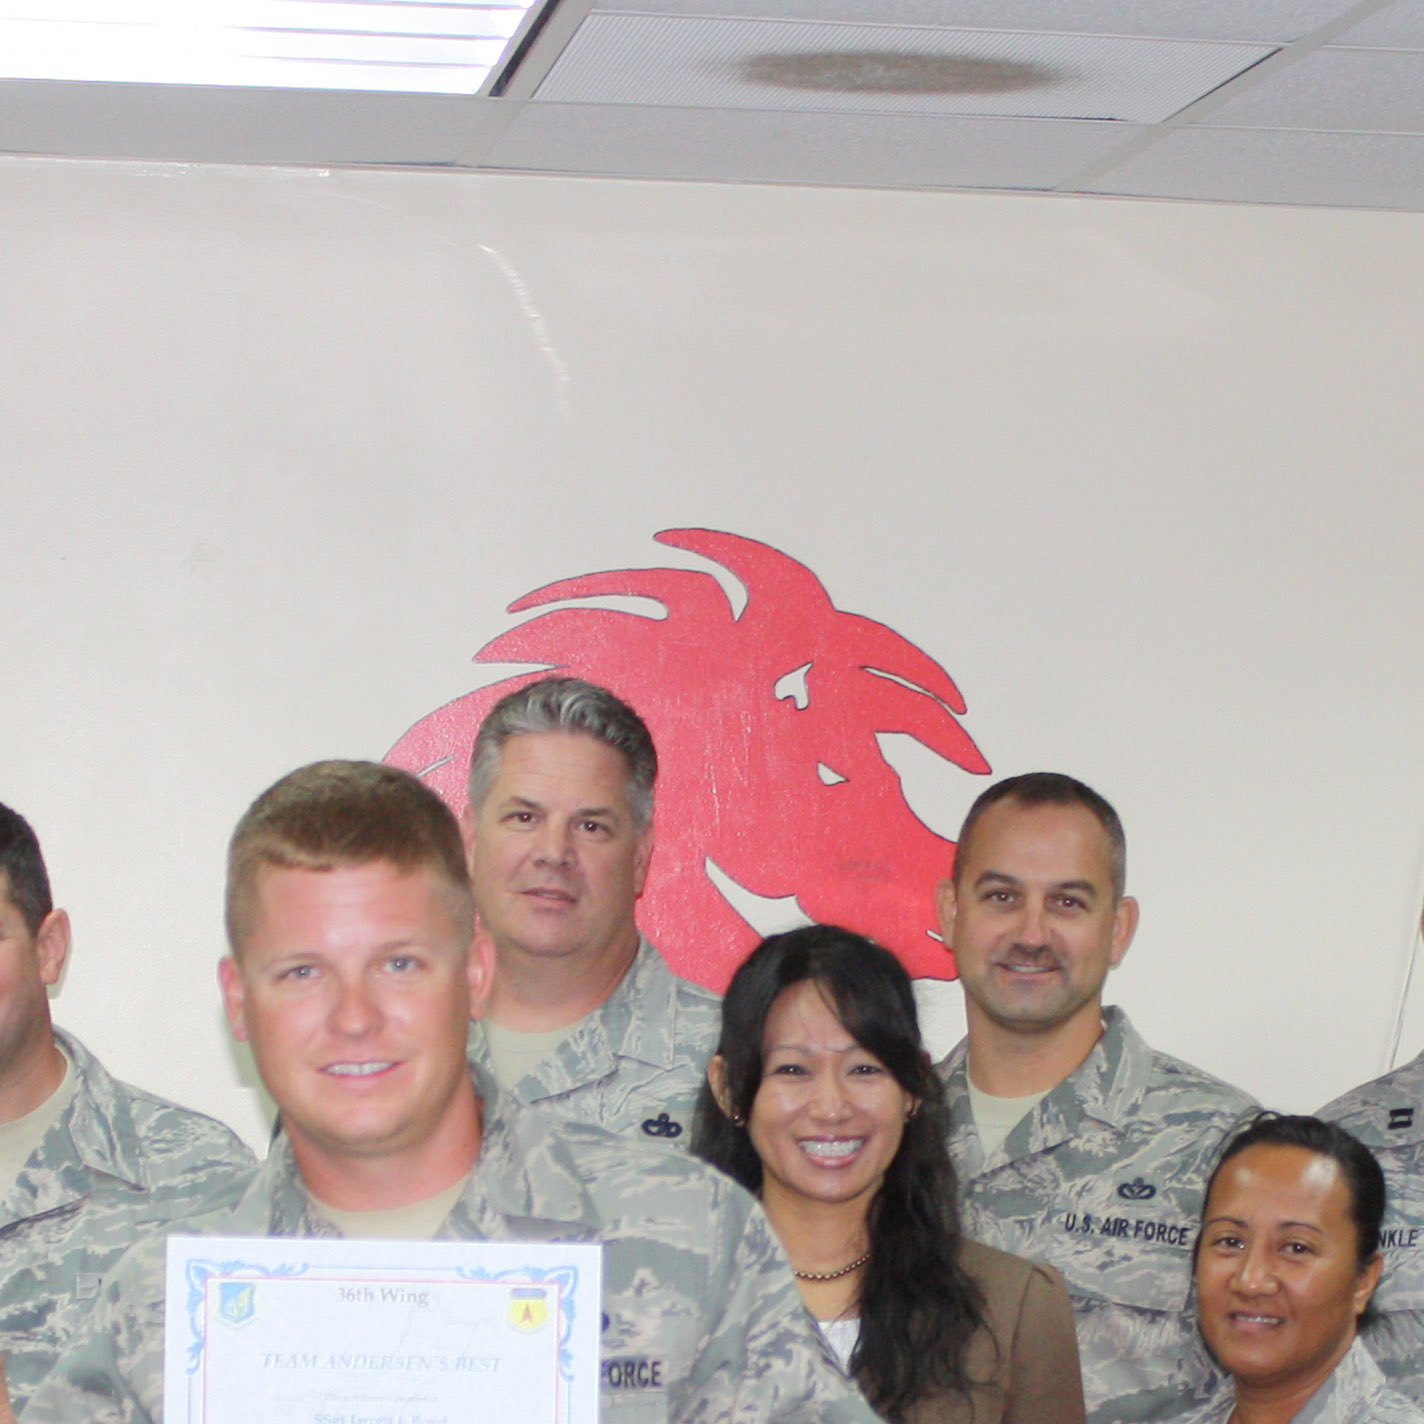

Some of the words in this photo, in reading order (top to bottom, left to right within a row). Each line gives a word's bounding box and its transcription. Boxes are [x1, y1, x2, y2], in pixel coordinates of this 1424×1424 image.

[1100, 1217, 1129, 1238] AIR
[1133, 1220, 1192, 1246] FORCE
[1378, 1229, 1419, 1248] NKLE
[337, 1287, 374, 1303] 36th
[380, 1287, 430, 1308] Wing
[262, 1353, 318, 1369] TEAM
[324, 1354, 449, 1371] ANDERSEN'S
[455, 1356, 502, 1372] BEST
[601, 1360, 662, 1388] ORCE
